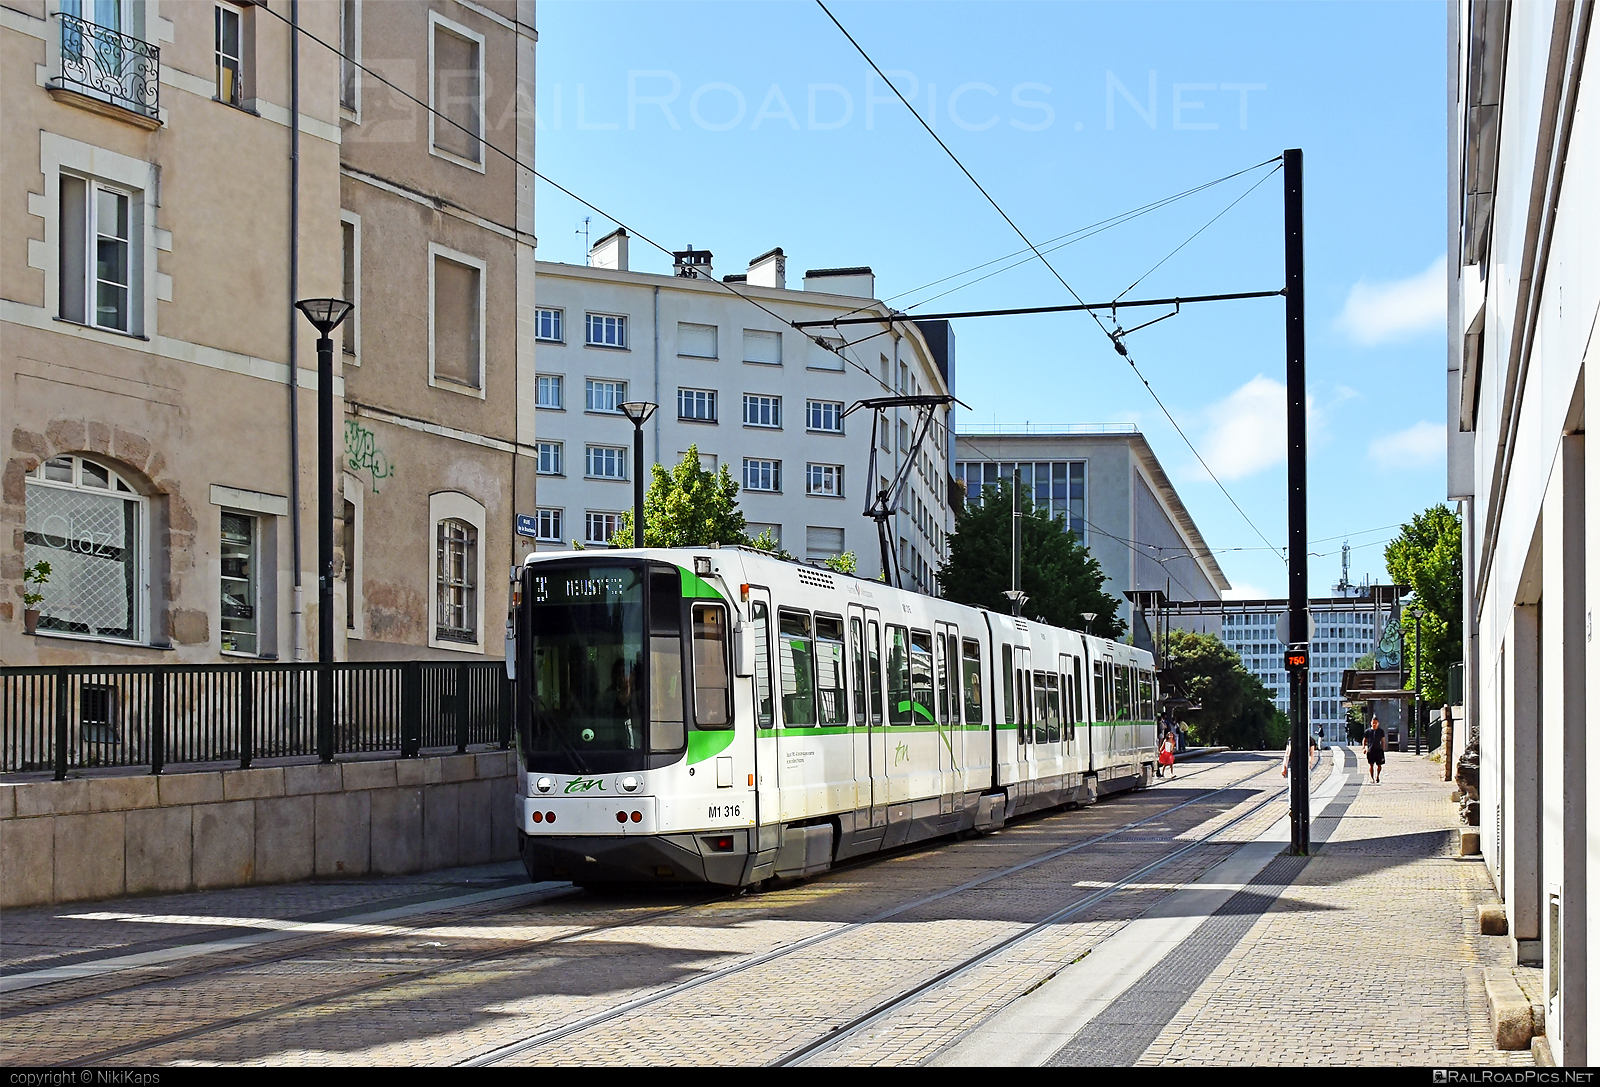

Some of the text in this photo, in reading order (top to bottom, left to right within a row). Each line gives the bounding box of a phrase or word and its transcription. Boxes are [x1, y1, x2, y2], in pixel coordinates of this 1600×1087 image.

[1288, 655, 1305, 666] 750
[689, 767, 696, 777] 9
[563, 776, 607, 794] tan
[708, 804, 741, 818] M1 316
